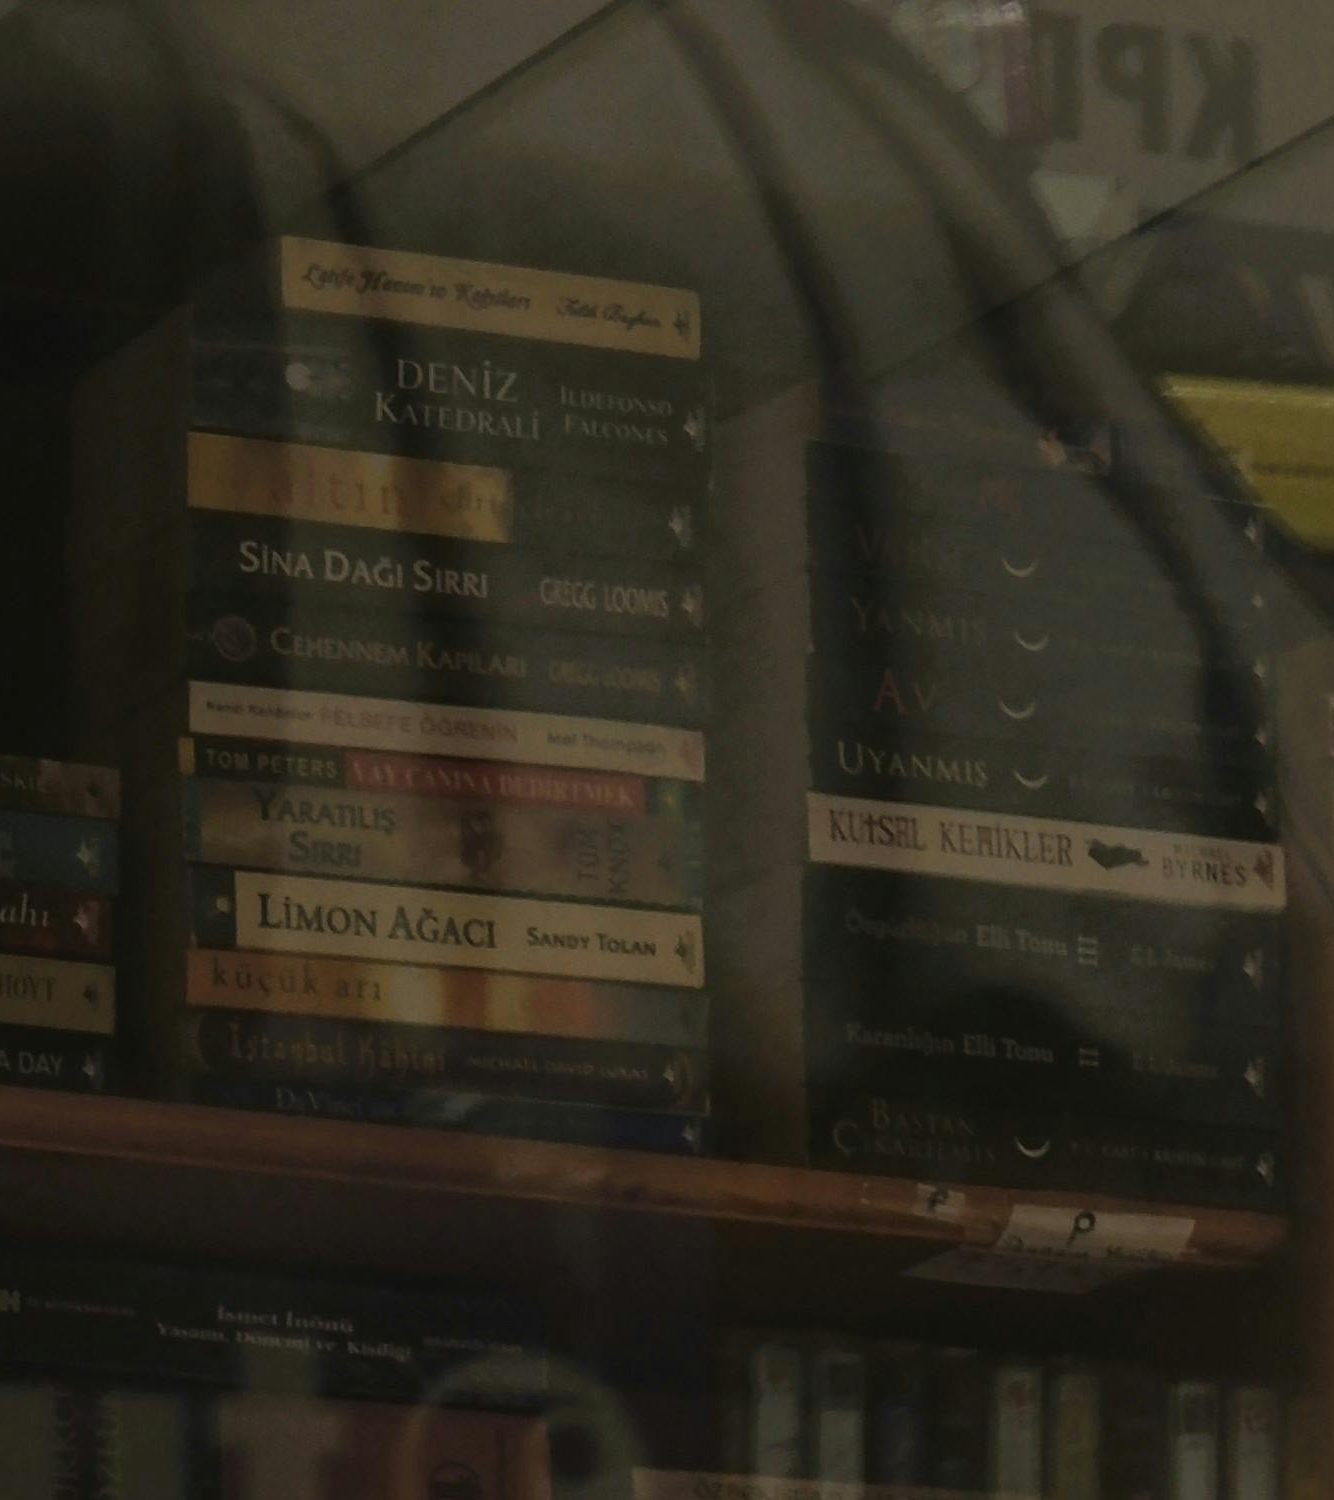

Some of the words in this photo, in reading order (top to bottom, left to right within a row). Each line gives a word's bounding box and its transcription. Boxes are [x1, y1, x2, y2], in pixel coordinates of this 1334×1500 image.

[397, 359, 519, 403] DENİZ
[374, 391, 541, 441] KATEDRALİ
[239, 539, 313, 581] SİNA
[322, 547, 405, 590] DAĞI
[412, 558, 489, 600] SIRRI
[270, 626, 411, 669] CEHENNEM
[416, 639, 527, 680] KAPILARI
[257, 751, 338, 780] PETERS
[258, 892, 378, 939] LİMON
[387, 908, 497, 950] AĞACI
[525, 924, 591, 952] SANDY
[16, 1049, 64, 1080] DAY
